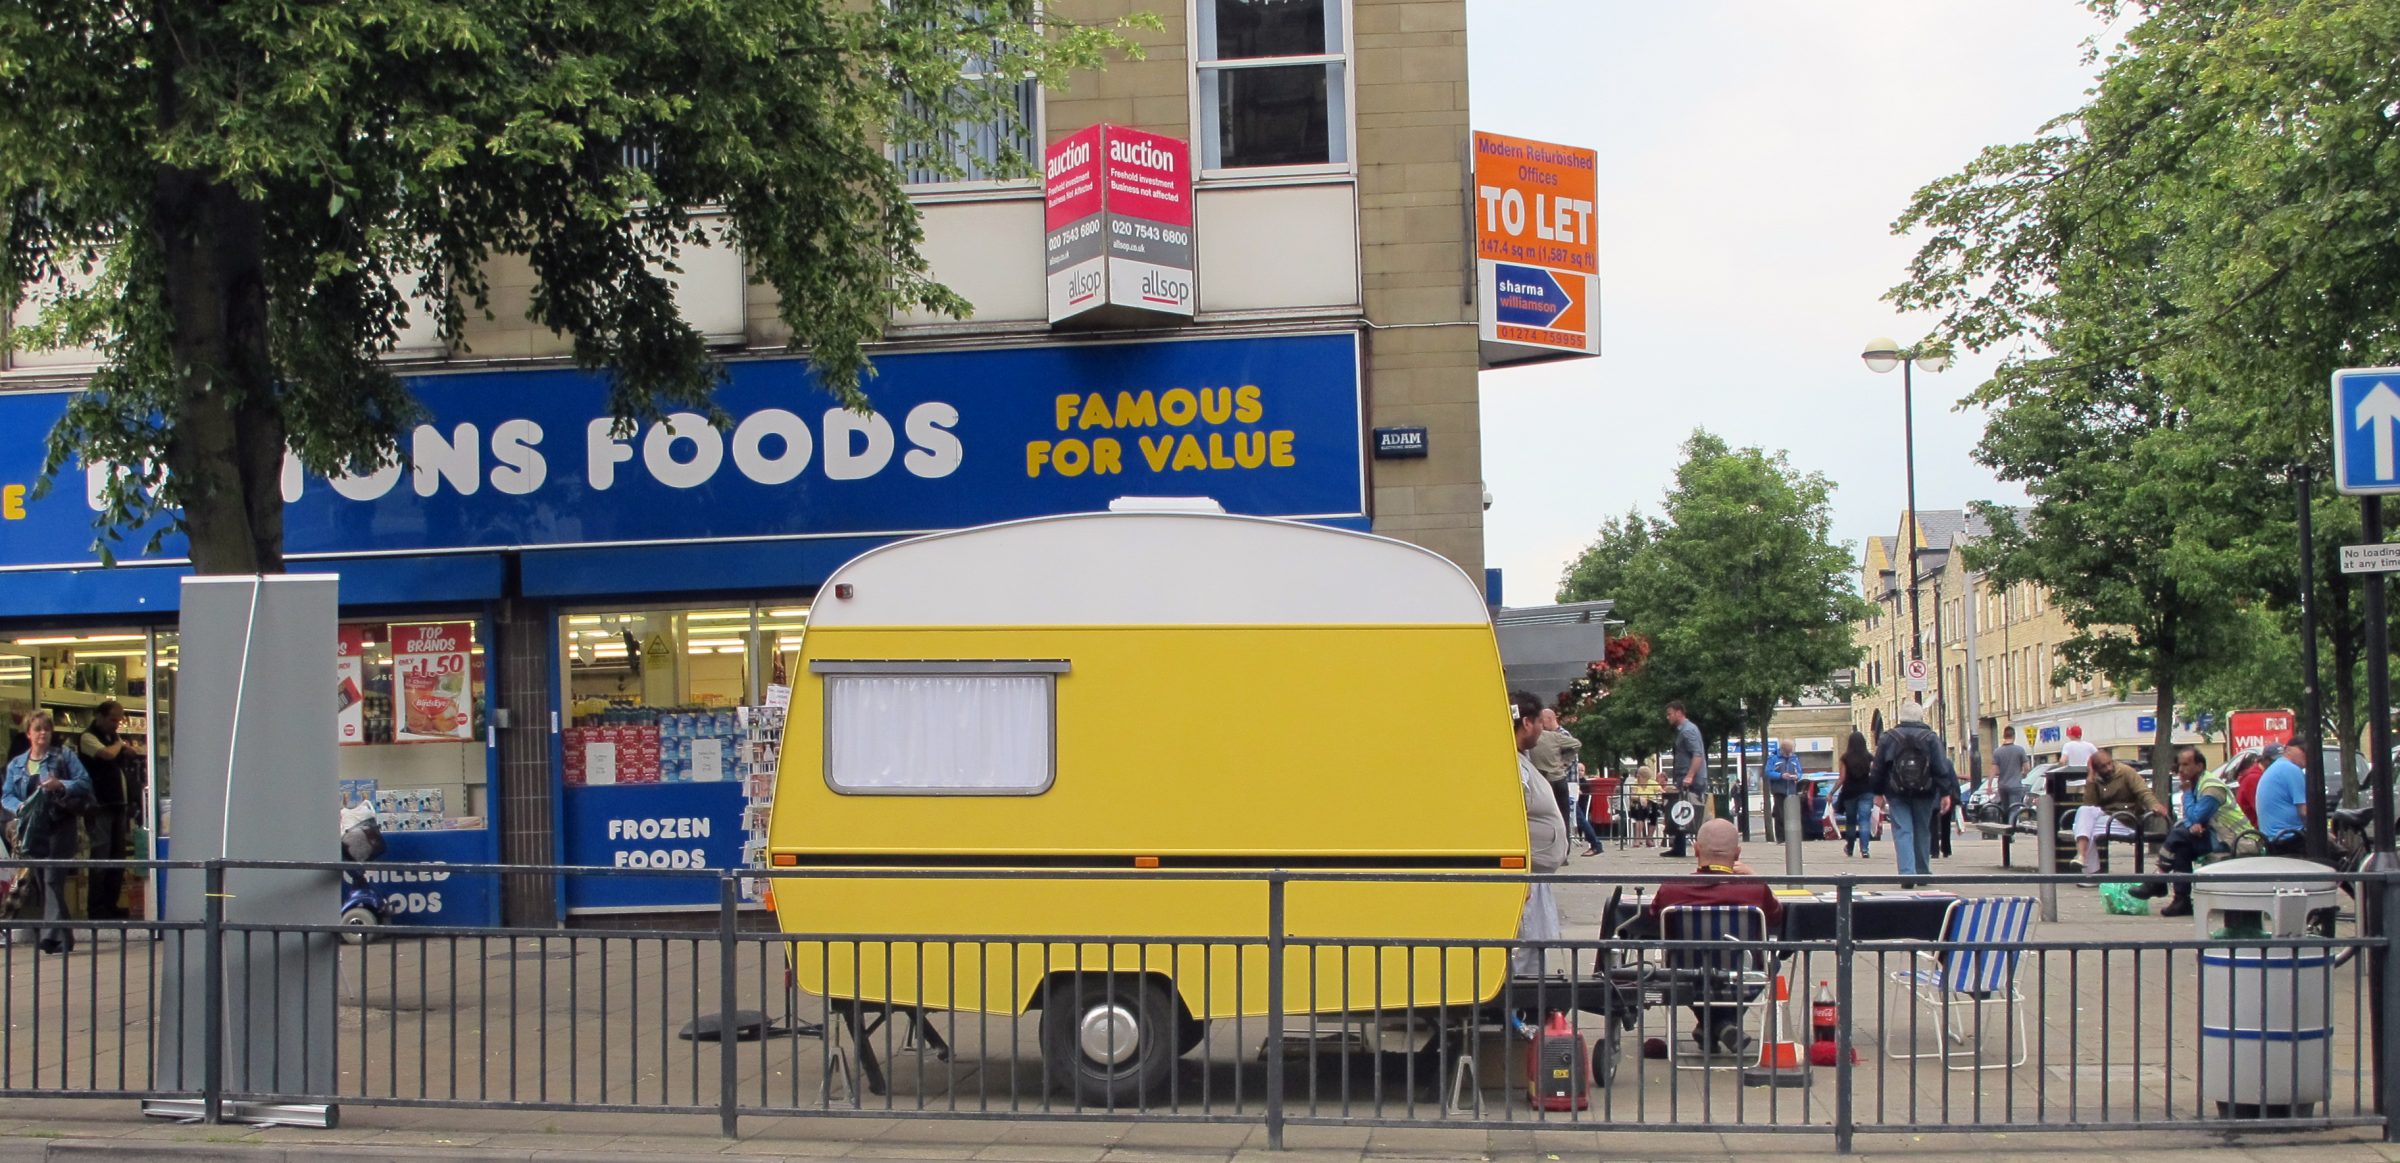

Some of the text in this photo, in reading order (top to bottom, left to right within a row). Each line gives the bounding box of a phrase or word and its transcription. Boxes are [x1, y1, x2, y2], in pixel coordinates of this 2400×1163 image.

[1048, 141, 1090, 180] auction
[1110, 139, 1174, 172] auction
[1479, 138, 1593, 170] Modern Refurbished
[1110, 167, 1175, 190] Freehold investment
[1518, 165, 1558, 186] Offices
[1110, 180, 1179, 203] Business not affected
[1480, 185, 1592, 246] TO LET
[1048, 219, 1100, 251] 020 7543 6800
[1112, 220, 1188, 246] 020 7543 6800
[1112, 239, 1145, 253] allsop.co.uk
[1481, 238, 1595, 268] 147.4 sq m (1,587 sq ft)
[1068, 269, 1101, 298] allsop
[1141, 270, 1189, 306] allsop
[1499, 280, 1544, 296] sharma
[1500, 296, 1557, 313] williamson
[1501, 326, 1583, 347] 01274 759955
[1056, 385, 1263, 431] FAMOUS
[587, 401, 964, 492] FOODS
[1381, 433, 1421, 445] ADAM
[1026, 430, 1296, 478] FOR VALUE
[2344, 561, 2354, 569] at
[2359, 560, 2376, 568] any
[2345, 548, 2400, 558] No loading
[420, 627, 442, 639] TOP
[407, 638, 456, 653] BRANDS
[411, 654, 464, 678] £1.50
[2235, 735, 2264, 748] WIN
[609, 817, 710, 840] FROZEN
[615, 848, 706, 869] FOODS
